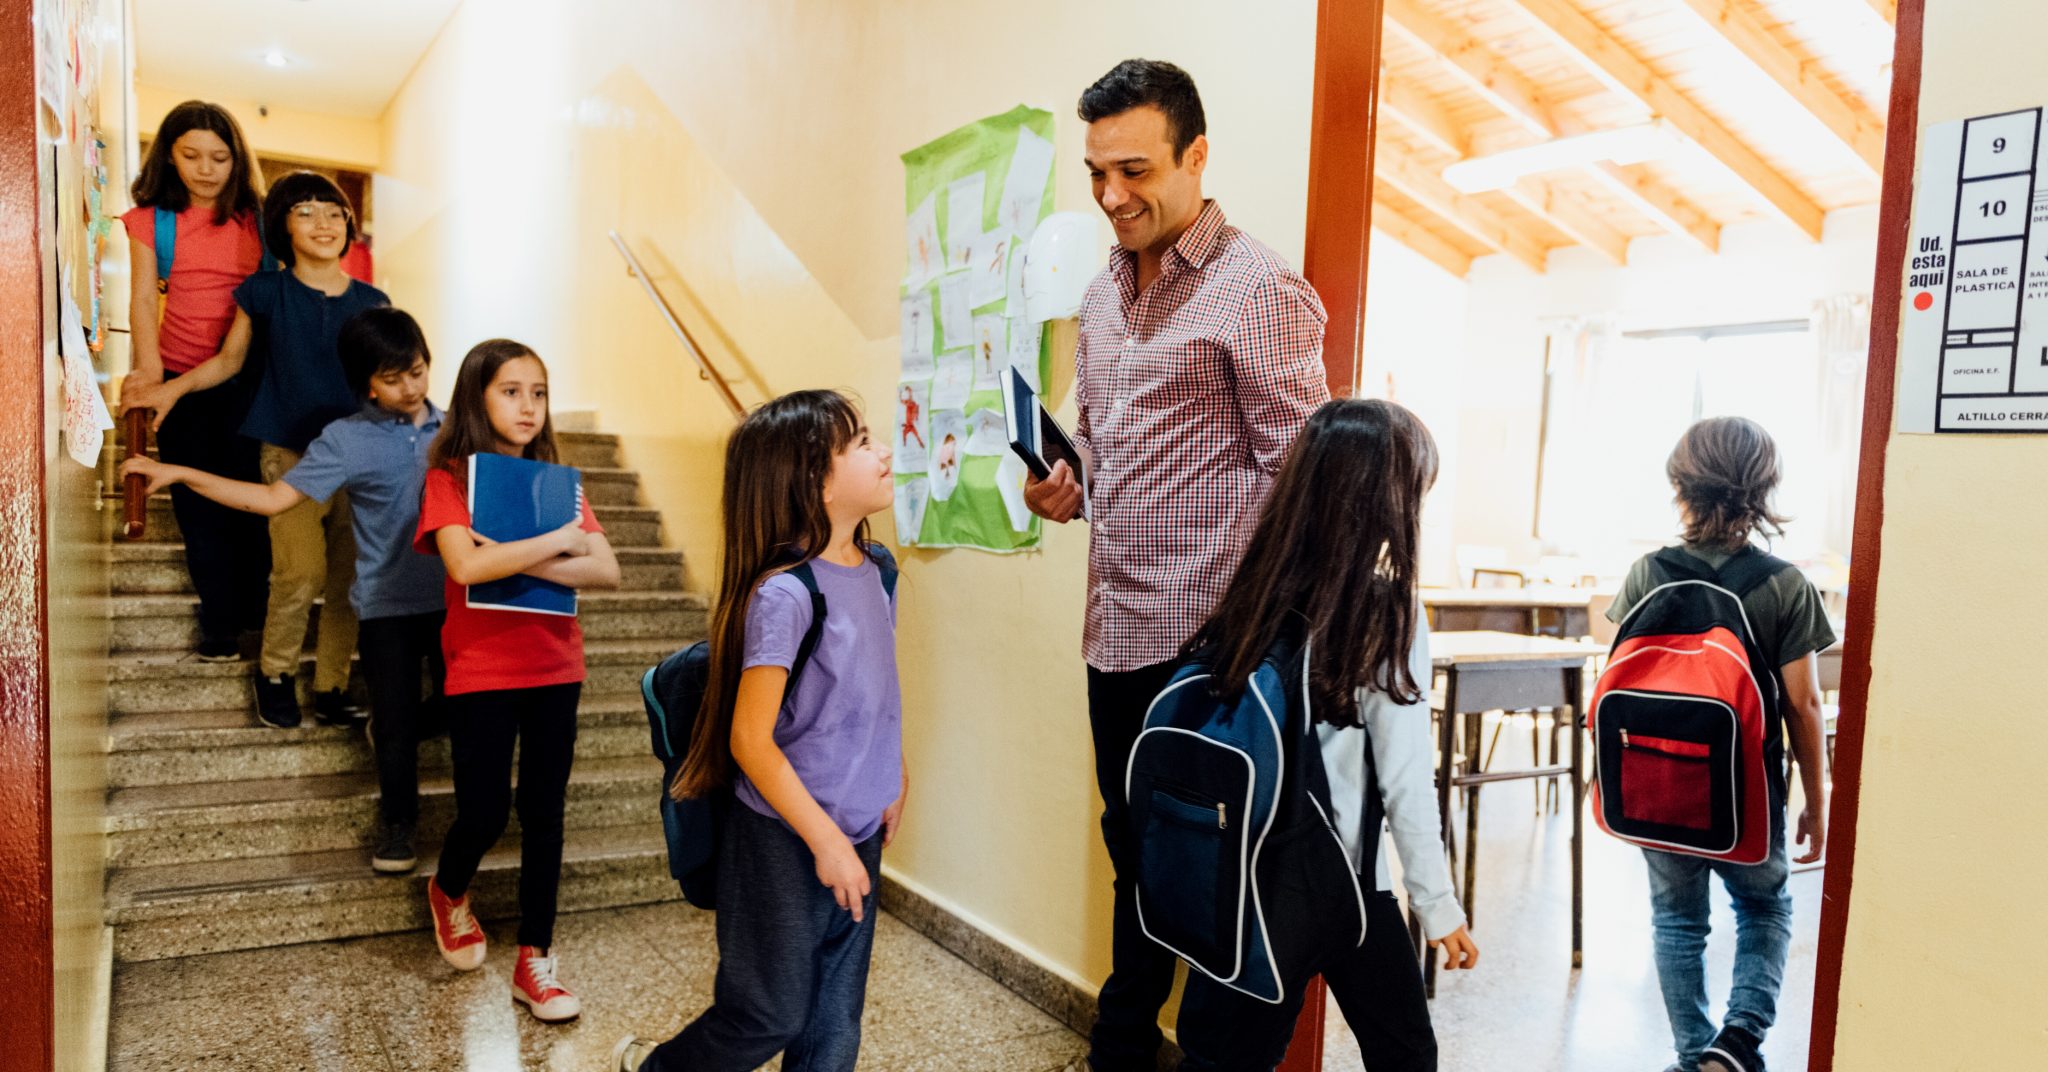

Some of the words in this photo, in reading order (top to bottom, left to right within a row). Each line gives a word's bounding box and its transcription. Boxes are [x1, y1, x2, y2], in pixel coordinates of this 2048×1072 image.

[1992, 137, 2007, 154] 9
[1979, 199, 2007, 217] 10
[1919, 236, 1943, 253] Ud.
[1912, 254, 1946, 270] esta
[1909, 270, 1944, 288] aqui
[1956, 268, 1988, 279] SALA
[1992, 266, 2008, 276] DE
[2029, 270, 2048, 278] SAL
[1954, 281, 2015, 293] PLASTICA
[1953, 368, 1985, 376] OFICINA
[1957, 412, 2006, 422] ALTILLO
